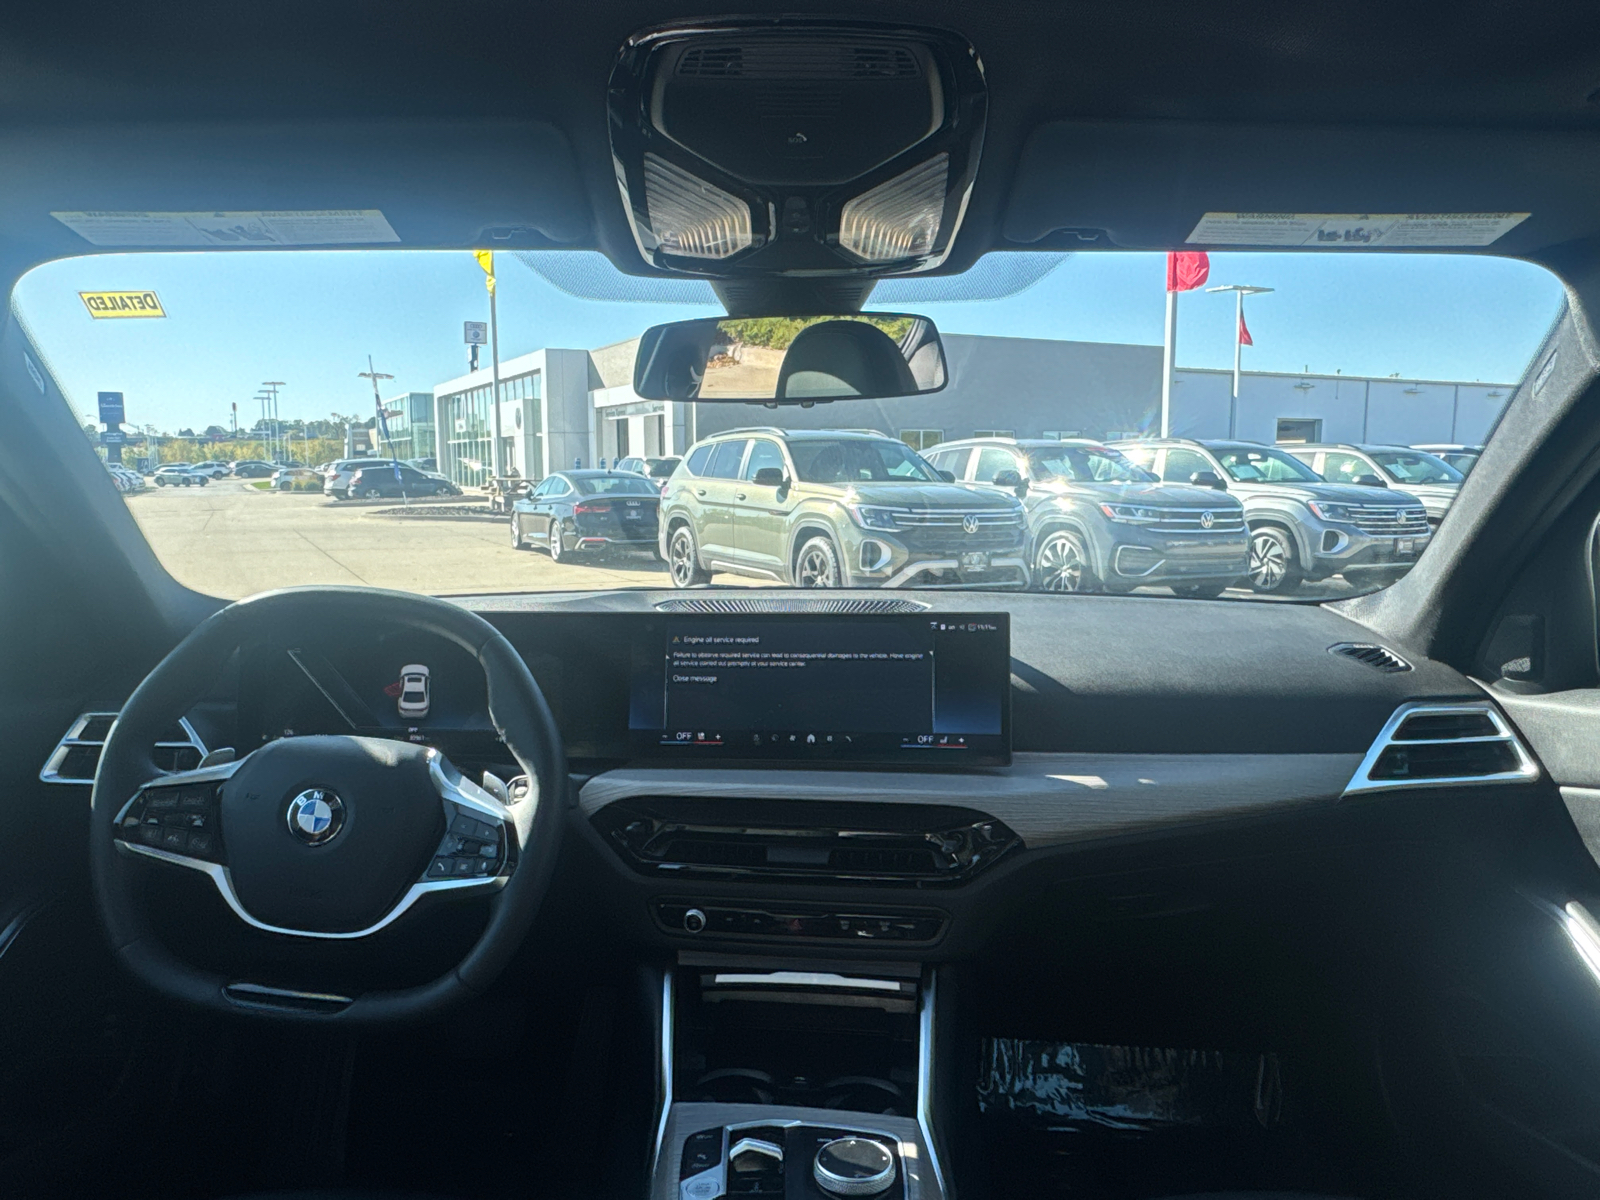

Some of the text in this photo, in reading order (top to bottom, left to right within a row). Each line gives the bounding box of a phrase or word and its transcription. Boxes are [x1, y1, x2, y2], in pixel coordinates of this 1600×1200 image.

[683, 636, 704, 644] Engine
[735, 636, 759, 645] required
[690, 675, 717, 684] message
[676, 732, 692, 740] OFF
[917, 735, 934, 743] OFF
